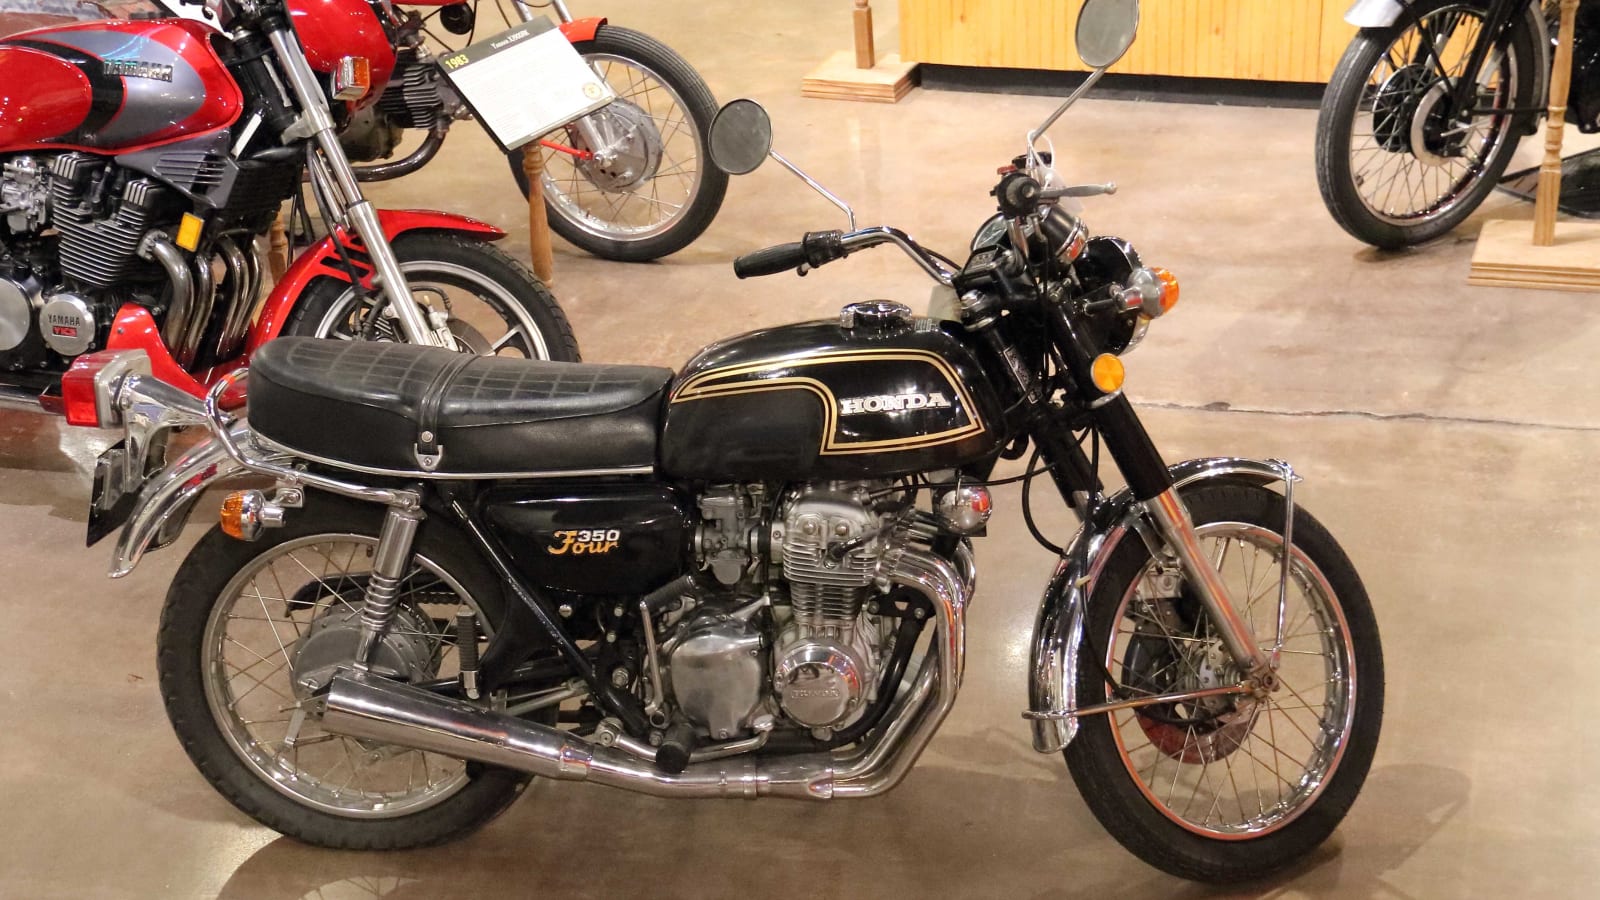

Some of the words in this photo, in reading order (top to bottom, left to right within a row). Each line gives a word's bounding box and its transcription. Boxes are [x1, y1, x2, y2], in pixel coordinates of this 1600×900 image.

[445, 54, 469, 69] 1983
[103, 60, 173, 82] YAMAHA
[48, 314, 81, 327] YAMAHA
[839, 392, 951, 416] HONDA
[547, 530, 619, 555] Four
[577, 530, 620, 542] 350
